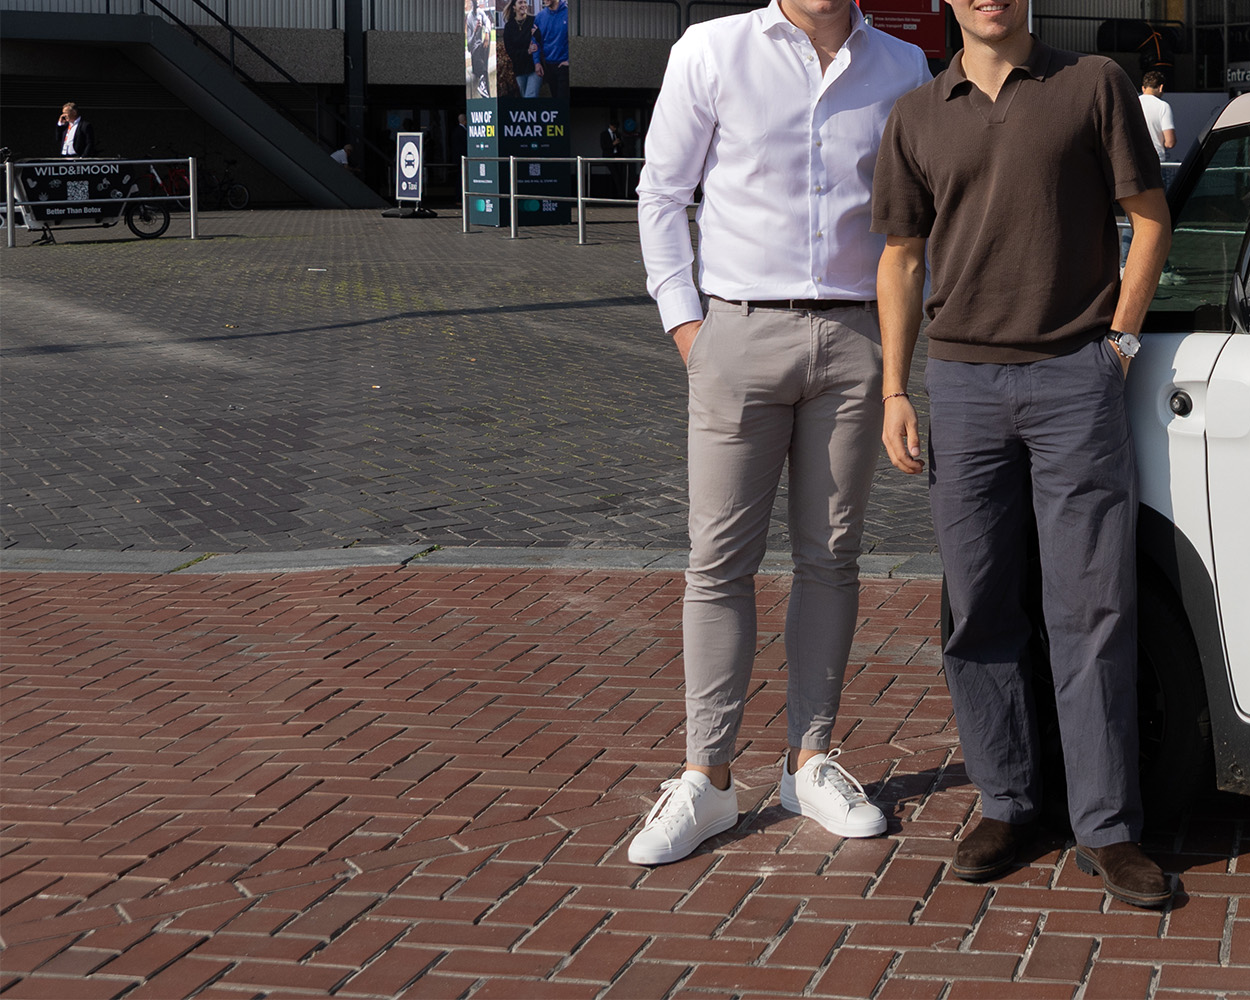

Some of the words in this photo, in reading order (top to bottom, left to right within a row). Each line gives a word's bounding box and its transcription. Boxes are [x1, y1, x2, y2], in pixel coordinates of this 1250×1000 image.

[471, 112, 483, 123] VAN
[484, 111, 493, 123] OF
[509, 111, 537, 123] VAN
[541, 111, 558, 123] OF
[469, 126, 486, 137] NAAR
[487, 126, 495, 137] EN
[504, 125, 542, 137] NAAR
[547, 125, 564, 136] EN
